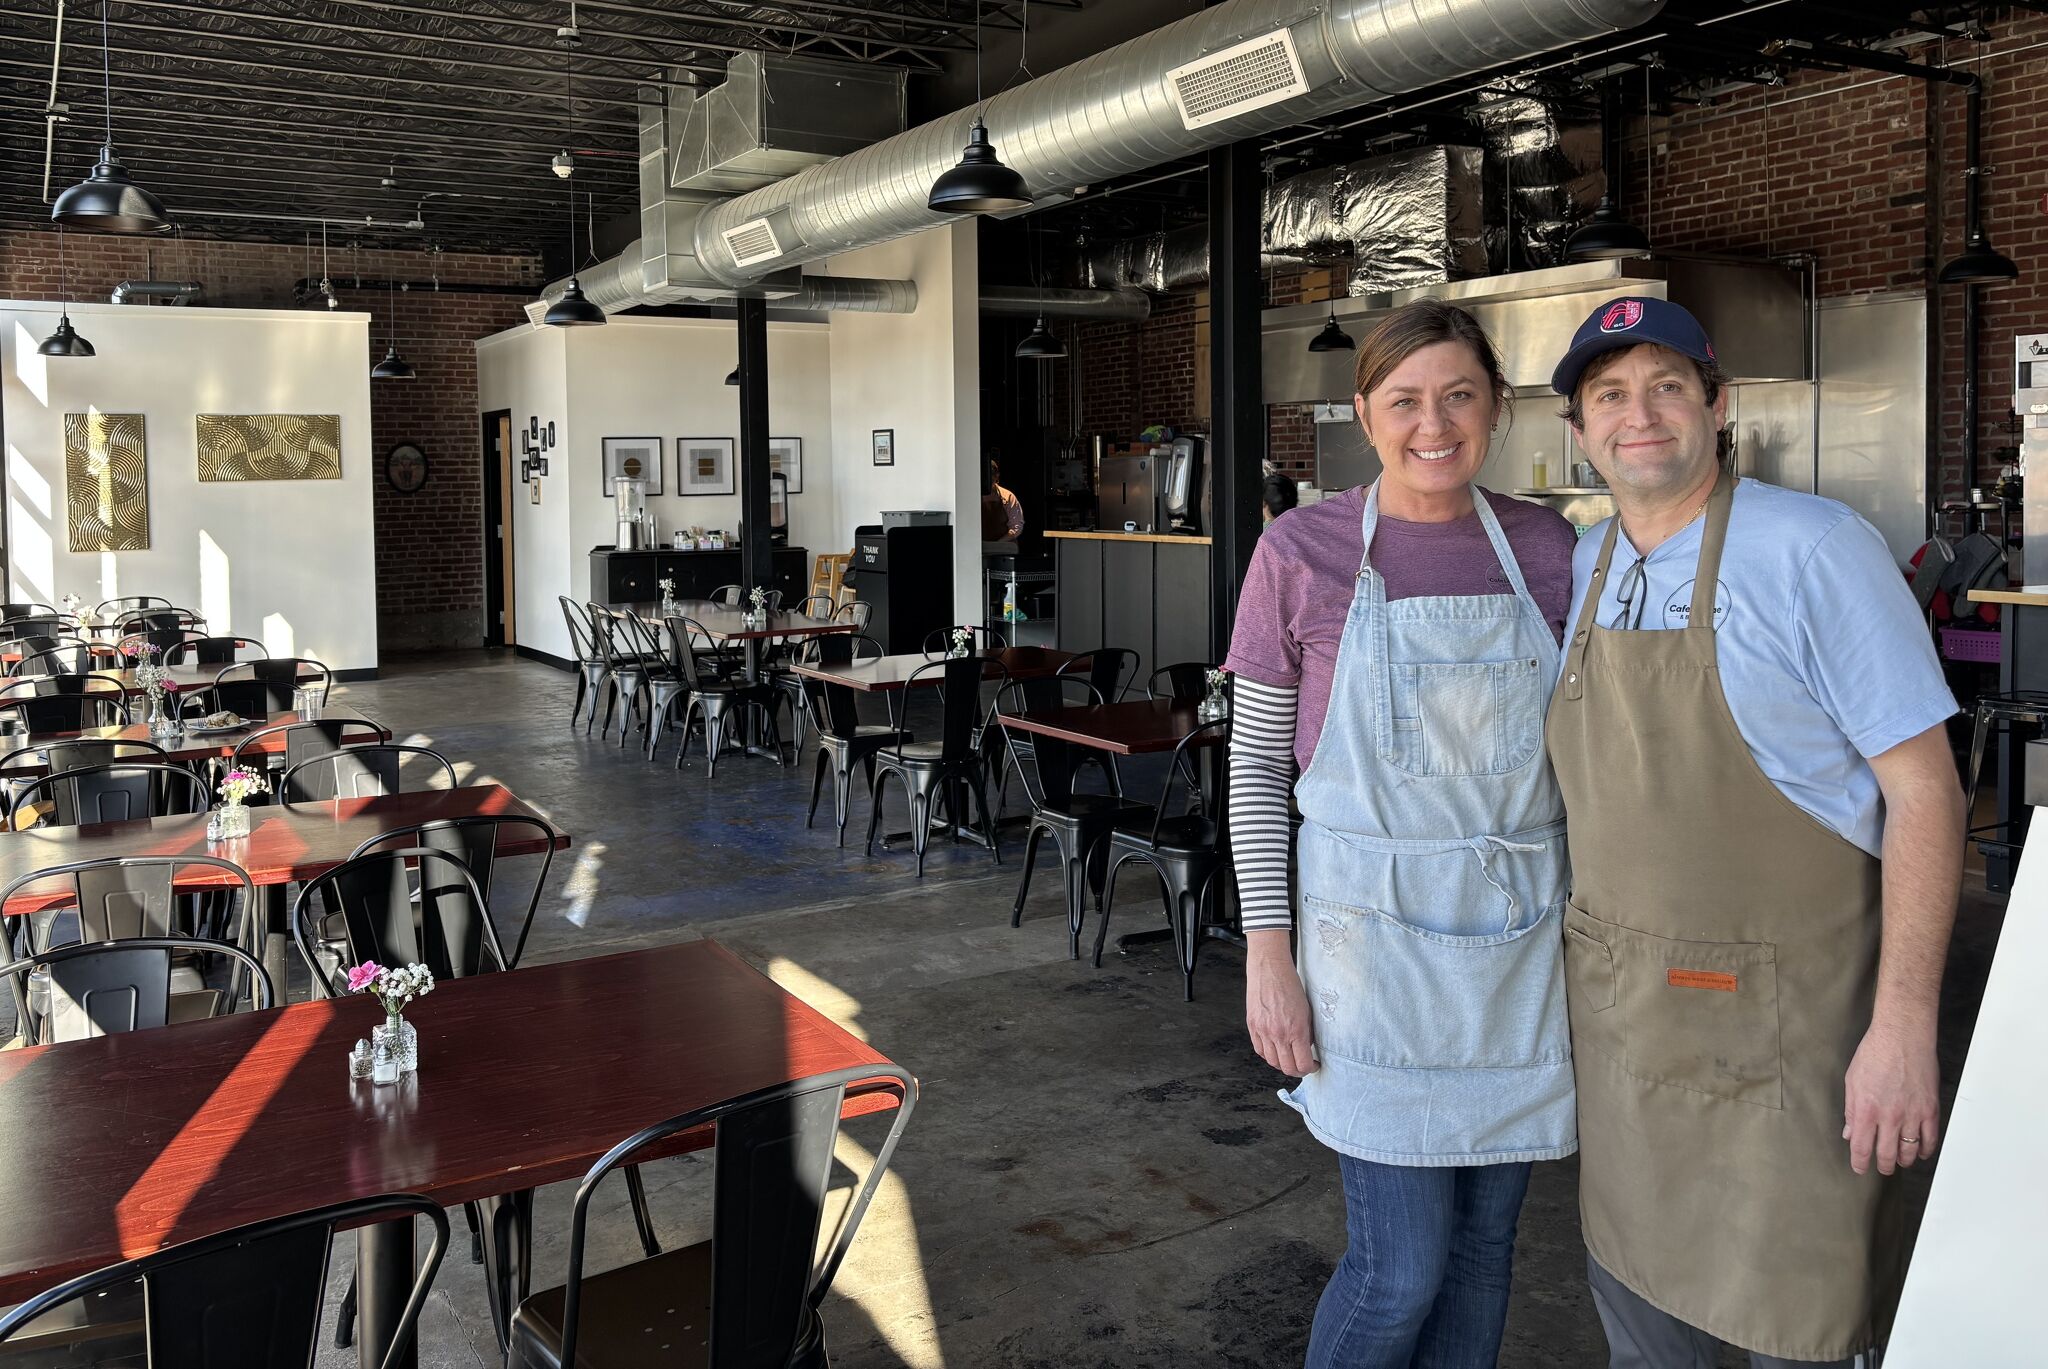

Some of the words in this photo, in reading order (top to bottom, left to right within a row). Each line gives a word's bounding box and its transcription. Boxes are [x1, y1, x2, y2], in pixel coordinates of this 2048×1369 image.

[863, 545, 879, 554] THANK
[865, 554, 876, 563] YOU
[1669, 604, 1691, 613] Cafe
